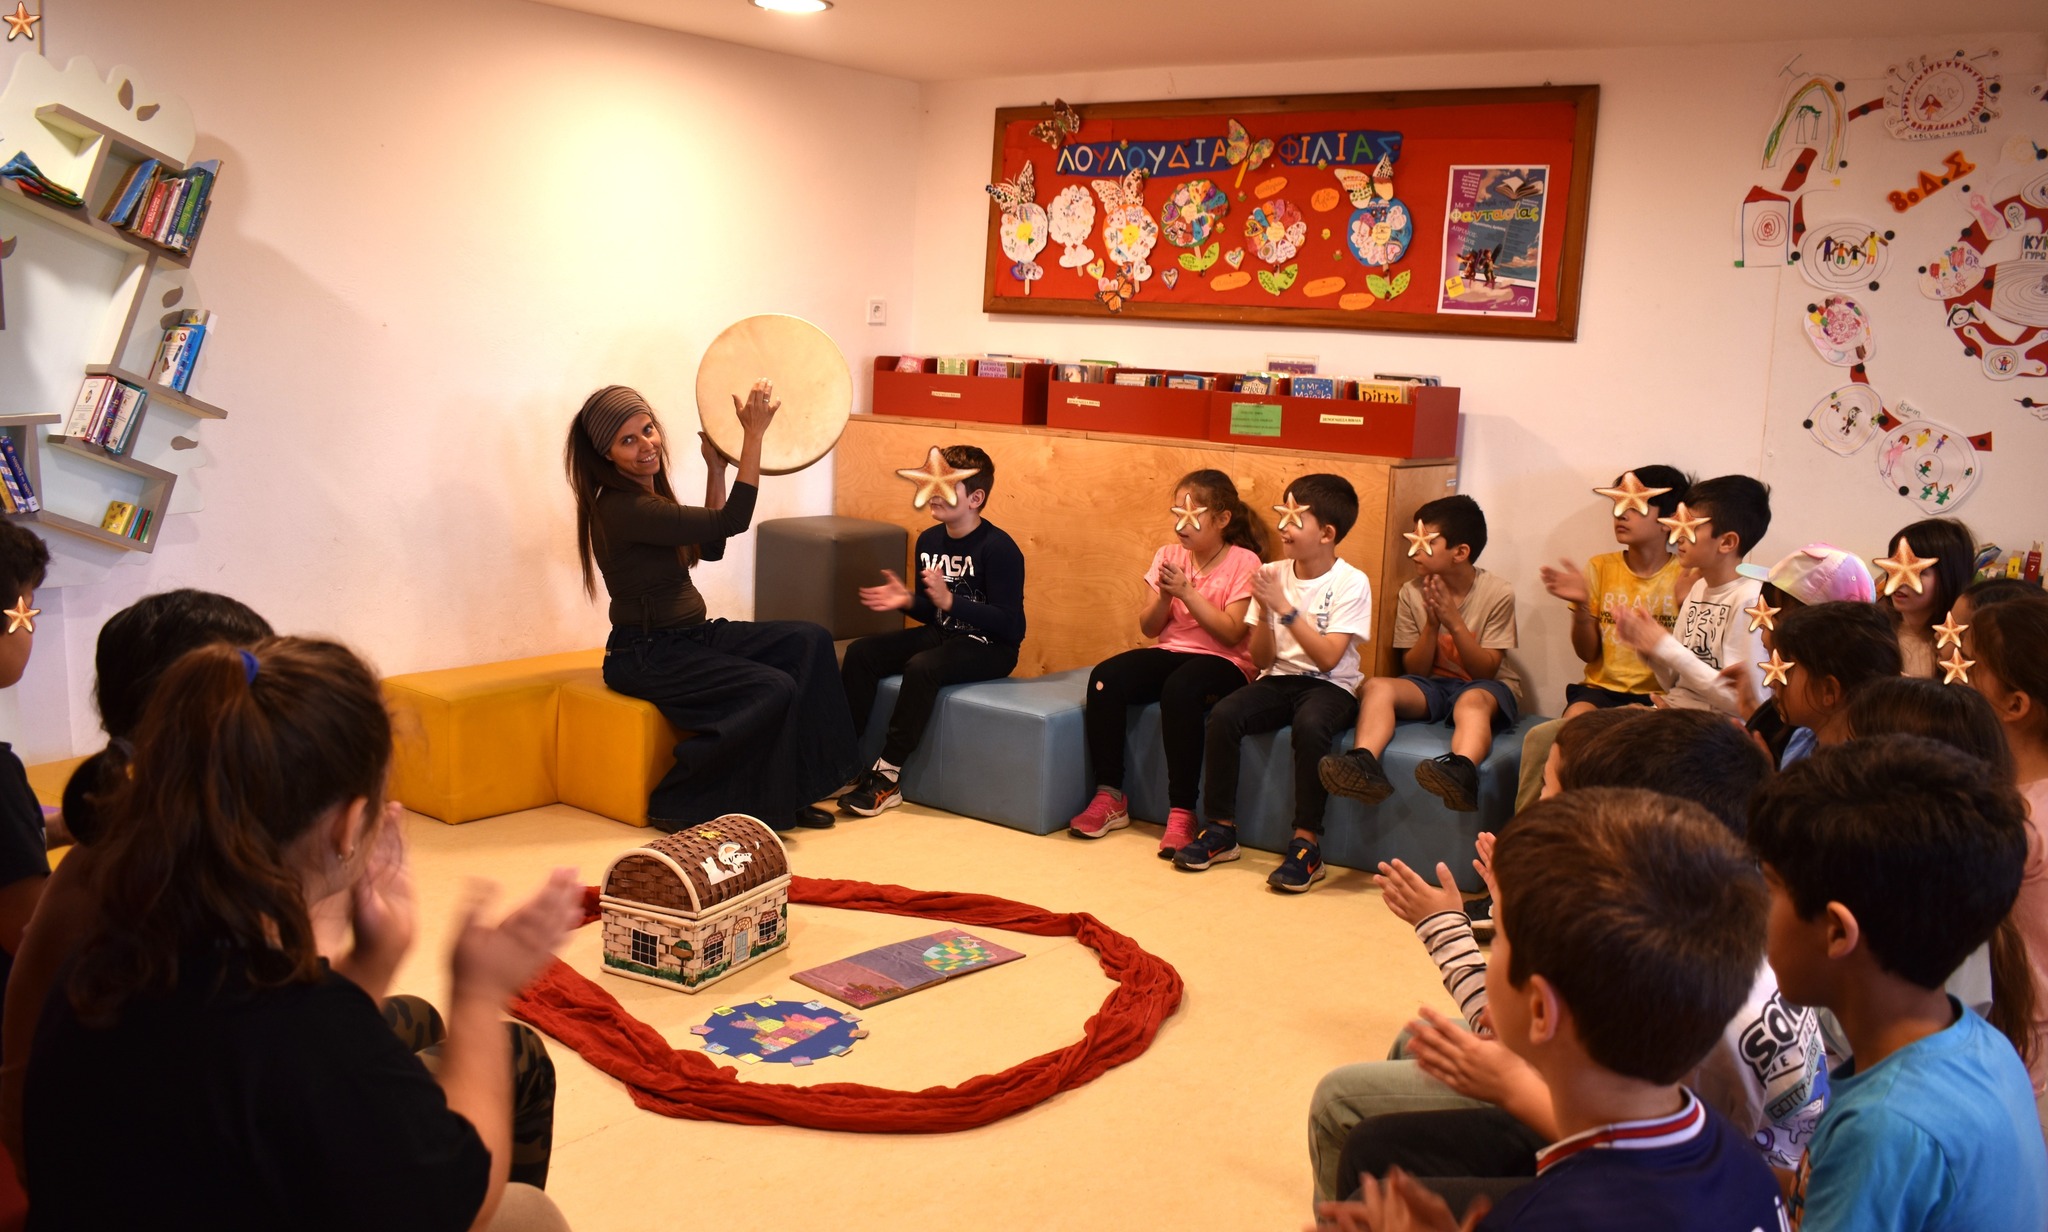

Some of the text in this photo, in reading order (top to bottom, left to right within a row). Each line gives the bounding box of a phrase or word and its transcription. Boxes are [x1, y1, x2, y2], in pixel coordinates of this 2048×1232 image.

[1057, 132, 1400, 175] ΛΟΥΛΟΥΔΙΑ ΦΙΛΙΑΣ
[1449, 201, 1540, 223] Φαντασίας
[920, 552, 975, 577] NASA
[1603, 592, 1674, 615] BRAVE
